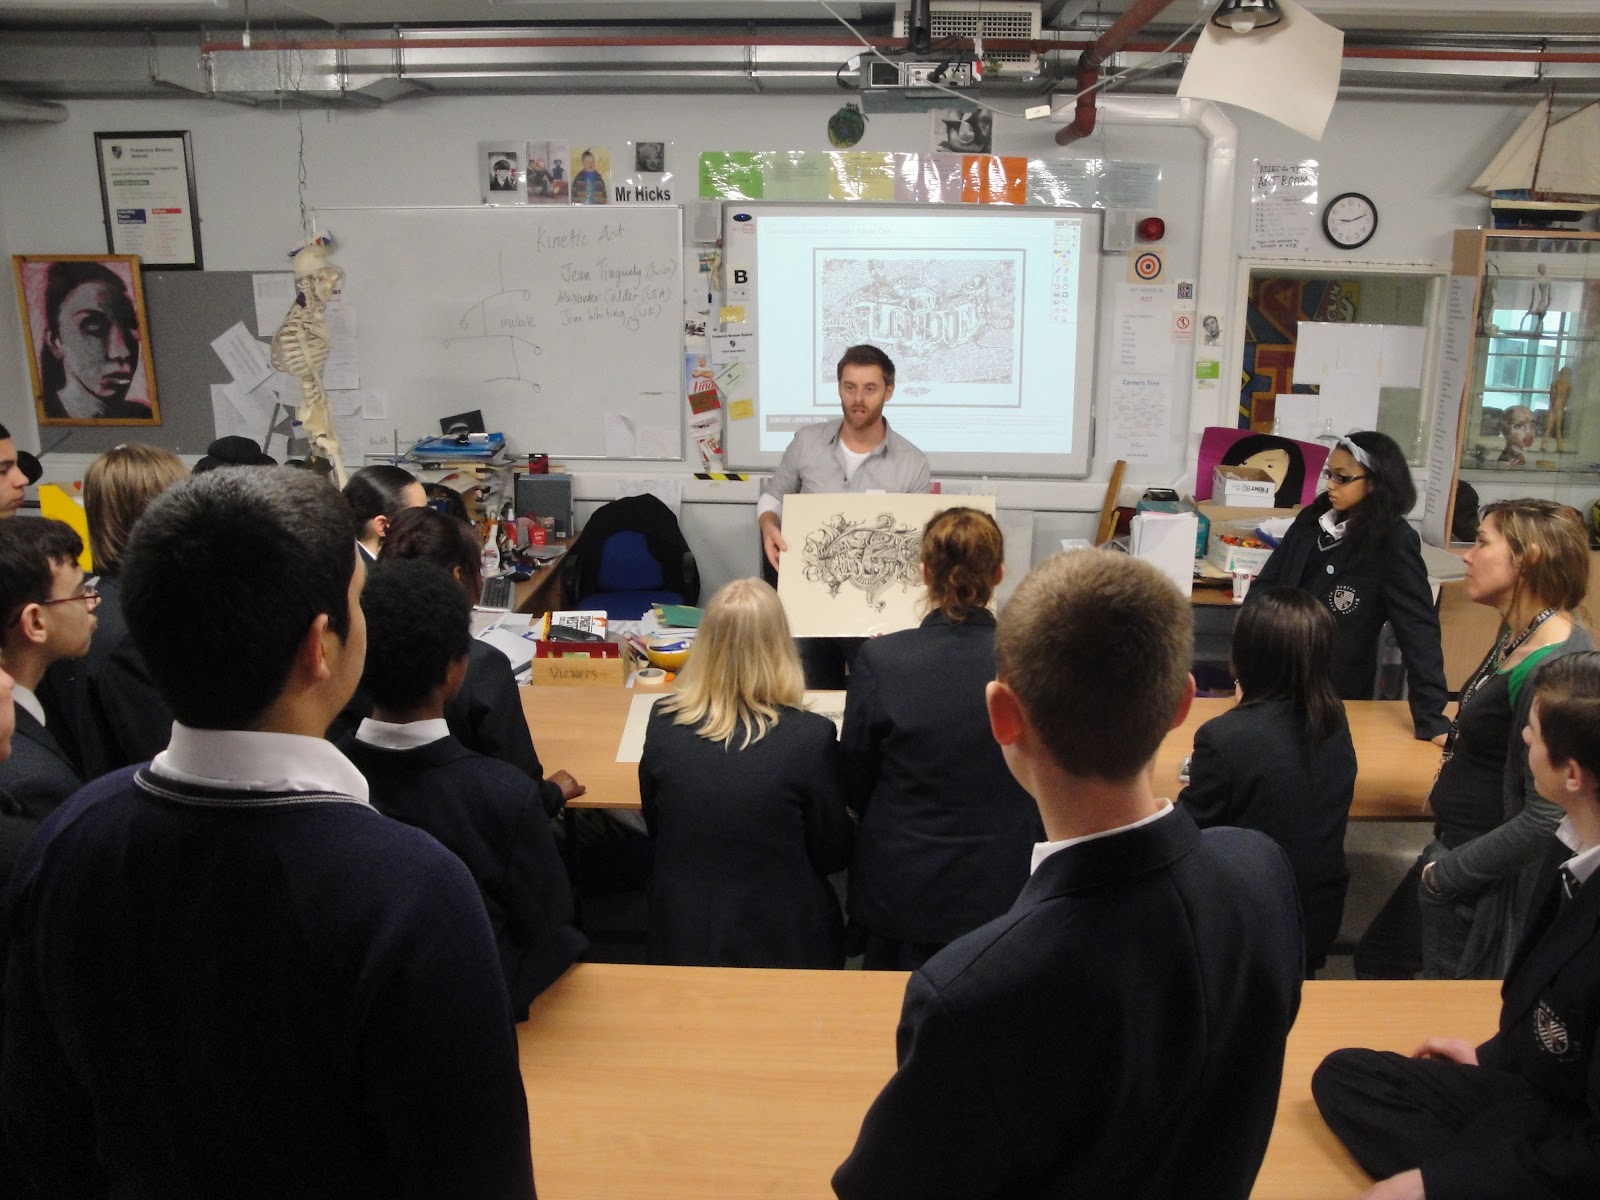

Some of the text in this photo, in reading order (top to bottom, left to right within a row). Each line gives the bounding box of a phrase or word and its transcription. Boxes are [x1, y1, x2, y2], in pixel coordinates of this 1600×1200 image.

[615, 186, 671, 202] Mr Hicks
[536, 223, 624, 252] Kinetic Art
[561, 262, 592, 283] Jean
[734, 269, 748, 284] B
[549, 667, 599, 679] Viewers
